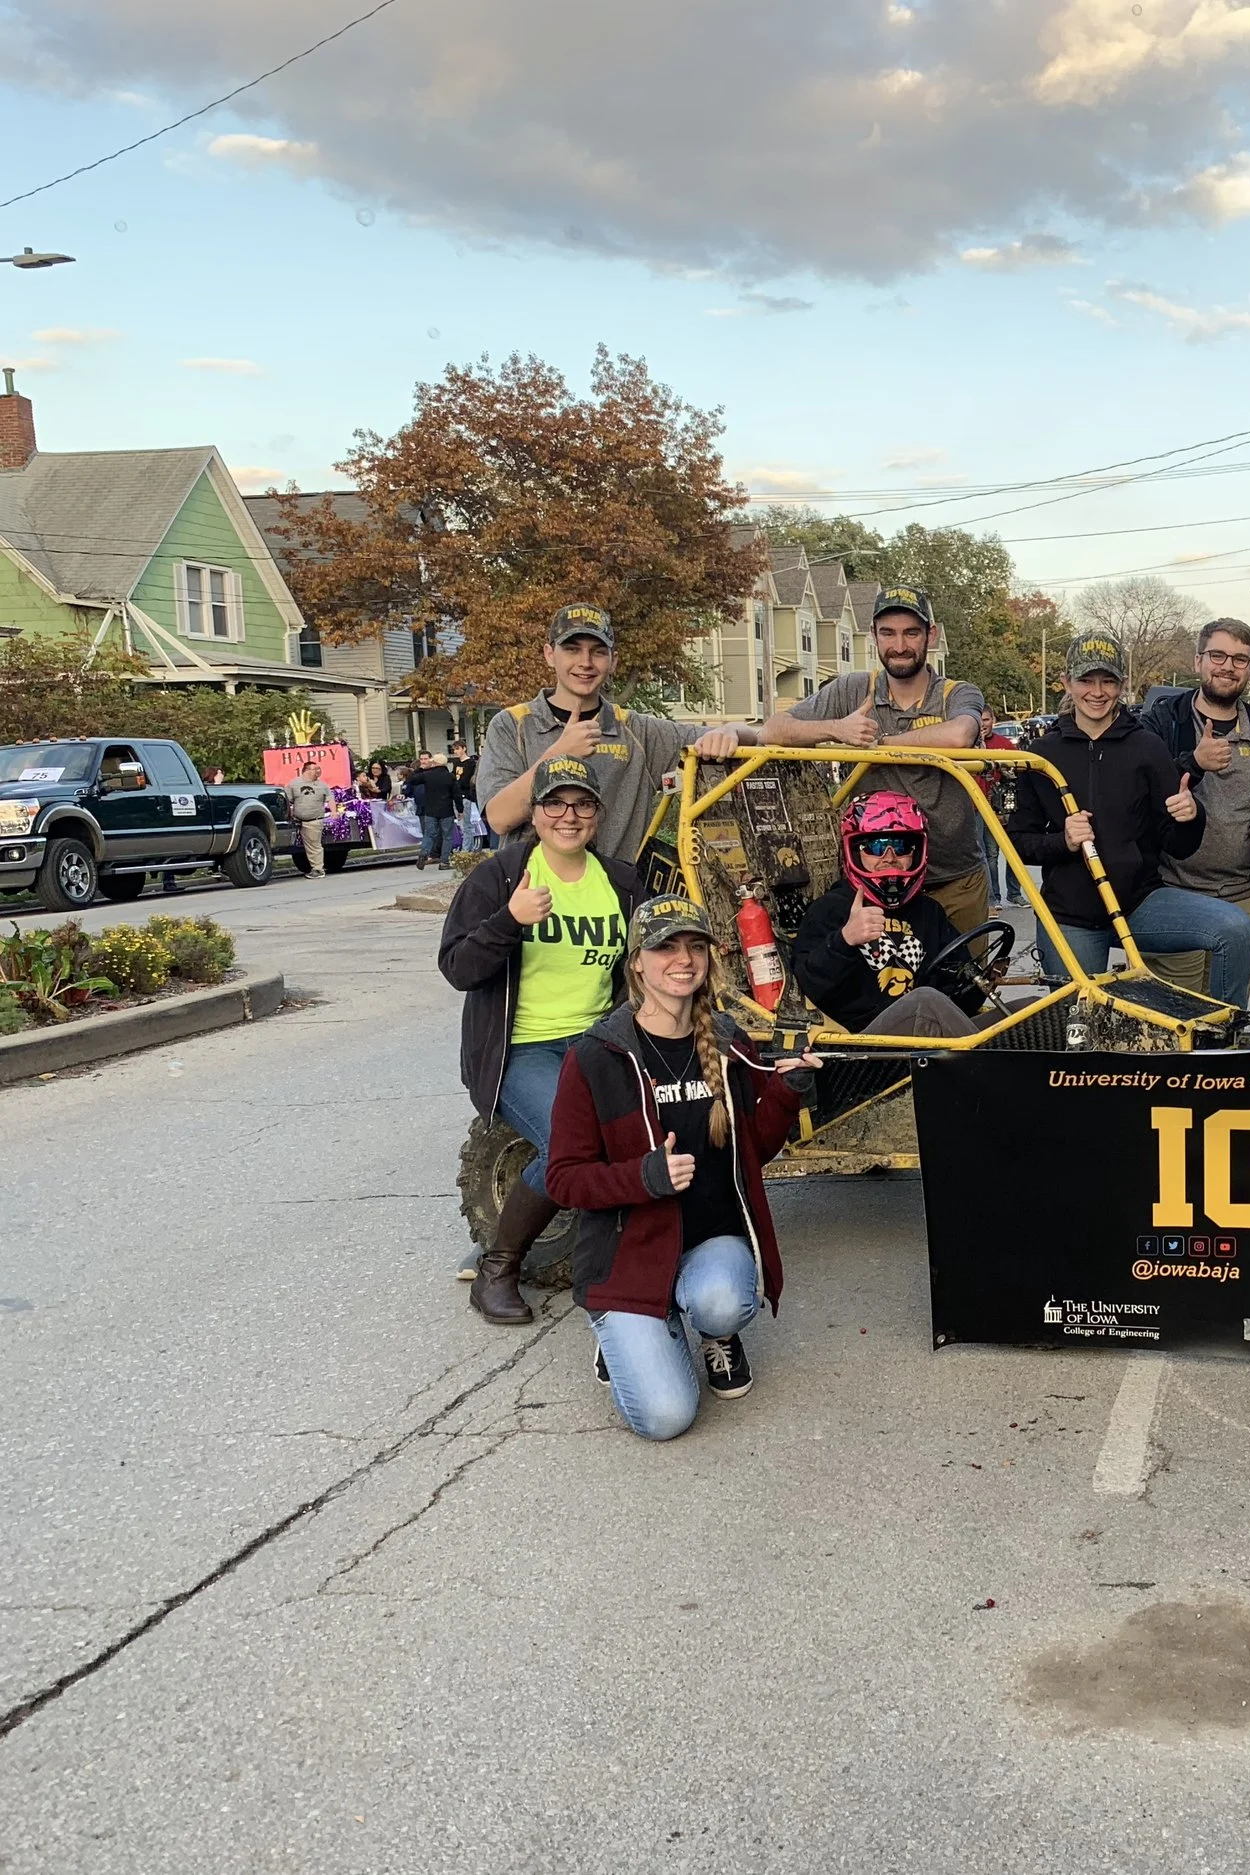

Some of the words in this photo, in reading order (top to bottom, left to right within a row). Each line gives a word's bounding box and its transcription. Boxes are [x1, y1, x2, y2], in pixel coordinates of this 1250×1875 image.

[885, 589, 917, 601] IOWA
[568, 608, 601, 619] IOWA
[1082, 640, 1115, 653] IOWA
[912, 716, 943, 729] IOWA
[282, 748, 338, 765] HAPPY
[596, 744, 628, 755] IOWA
[549, 760, 587, 774] IOWA
[652, 900, 699, 917] IOWA
[521, 912, 625, 947] IOWA
[884, 918, 914, 936] ISE
[581, 949, 621, 971] Baj
[1048, 1070, 1161, 1090] University
[1167, 1071, 1192, 1089] of
[1194, 1073, 1245, 1090] Iowa
[655, 1083, 681, 1104] GHT
[1132, 1260, 1240, 1281] @iowabaja
[1063, 1300, 1088, 1312] THE
[1091, 1301, 1160, 1315] UNIVERSITY
[1067, 1314, 1083, 1323] OF
[1087, 1312, 1118, 1325] IOWA
[1063, 1327, 1094, 1337] College
[1109, 1328, 1160, 1340] Engineering
